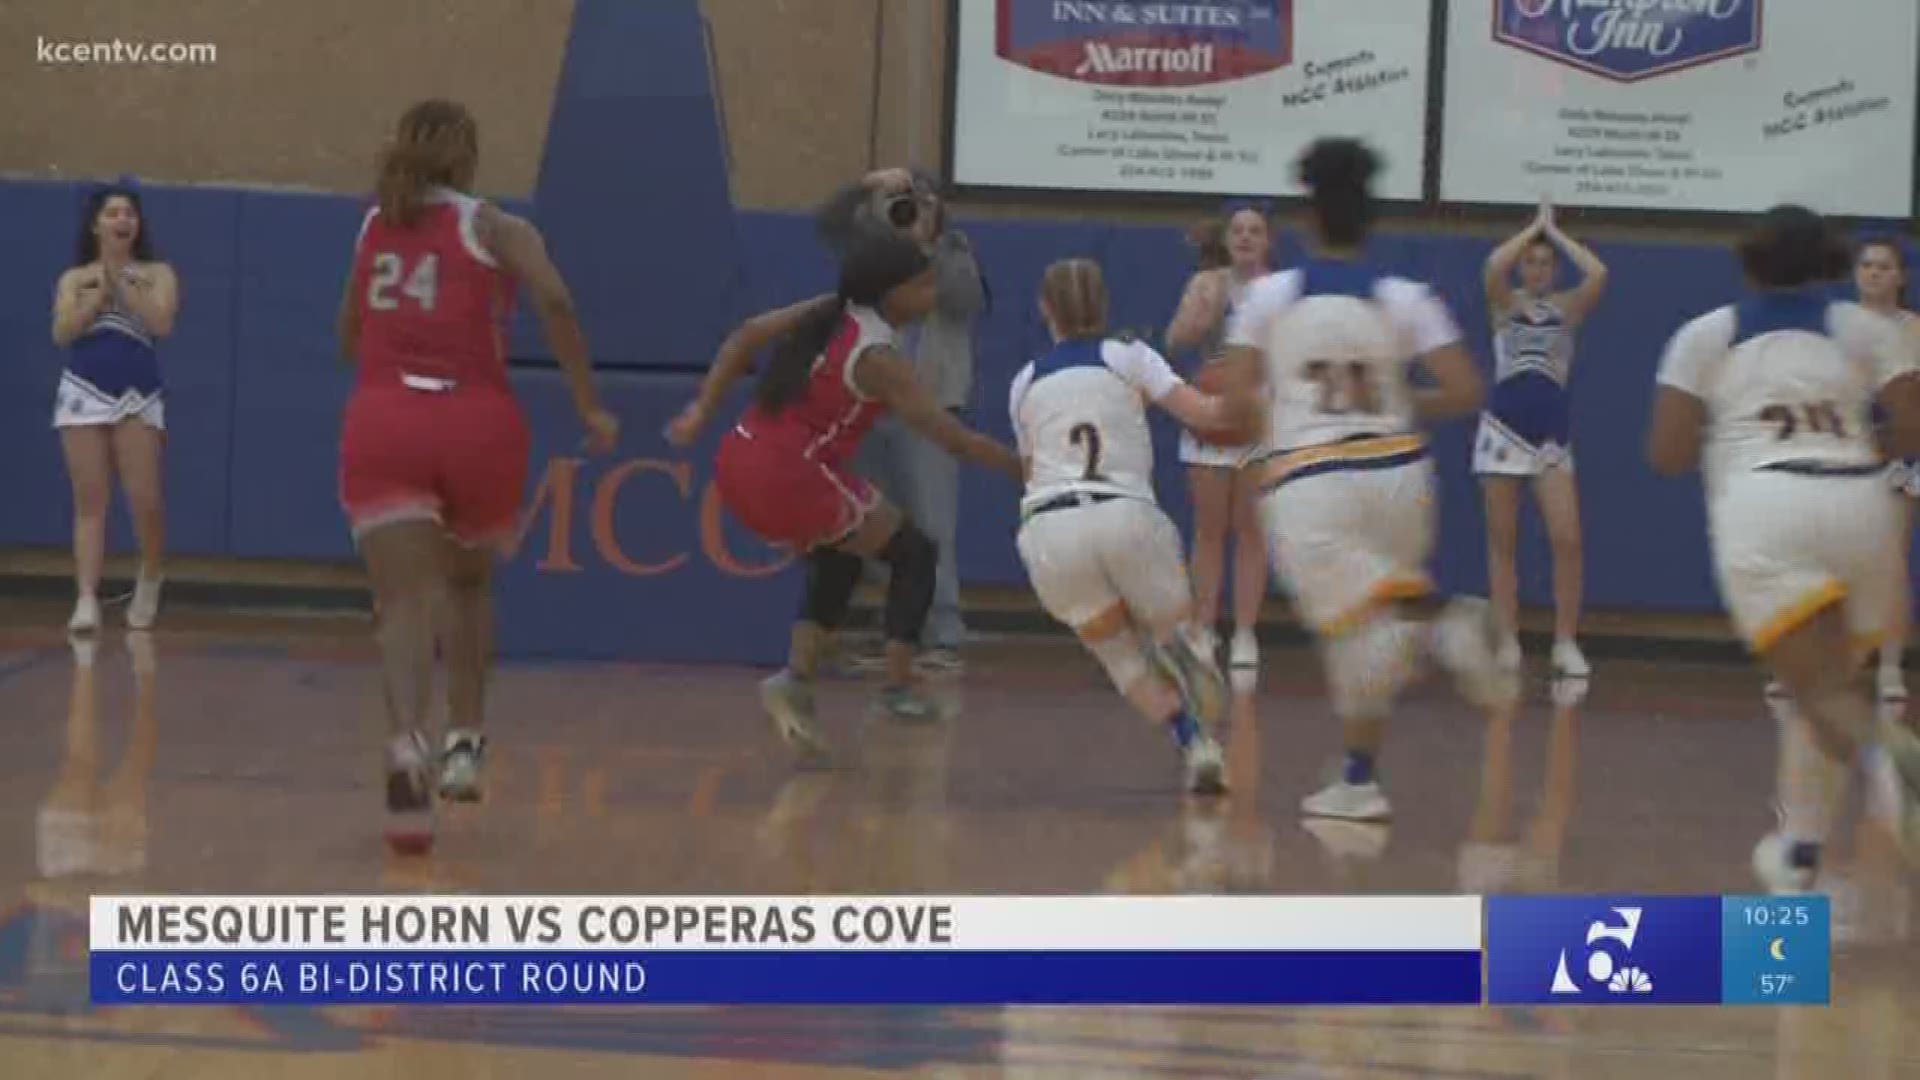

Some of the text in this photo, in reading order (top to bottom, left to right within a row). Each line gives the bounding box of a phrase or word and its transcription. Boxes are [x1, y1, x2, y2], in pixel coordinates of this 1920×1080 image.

[1052, 0, 1106, 22] INN
[1111, 2, 1137, 24] &
[1142, 3, 1240, 27] SUITES
[1567, 8, 1681, 55] Inn
[1075, 42, 1215, 75] Marriott
[367, 252, 439, 312] 24
[1069, 421, 1112, 482] 2
